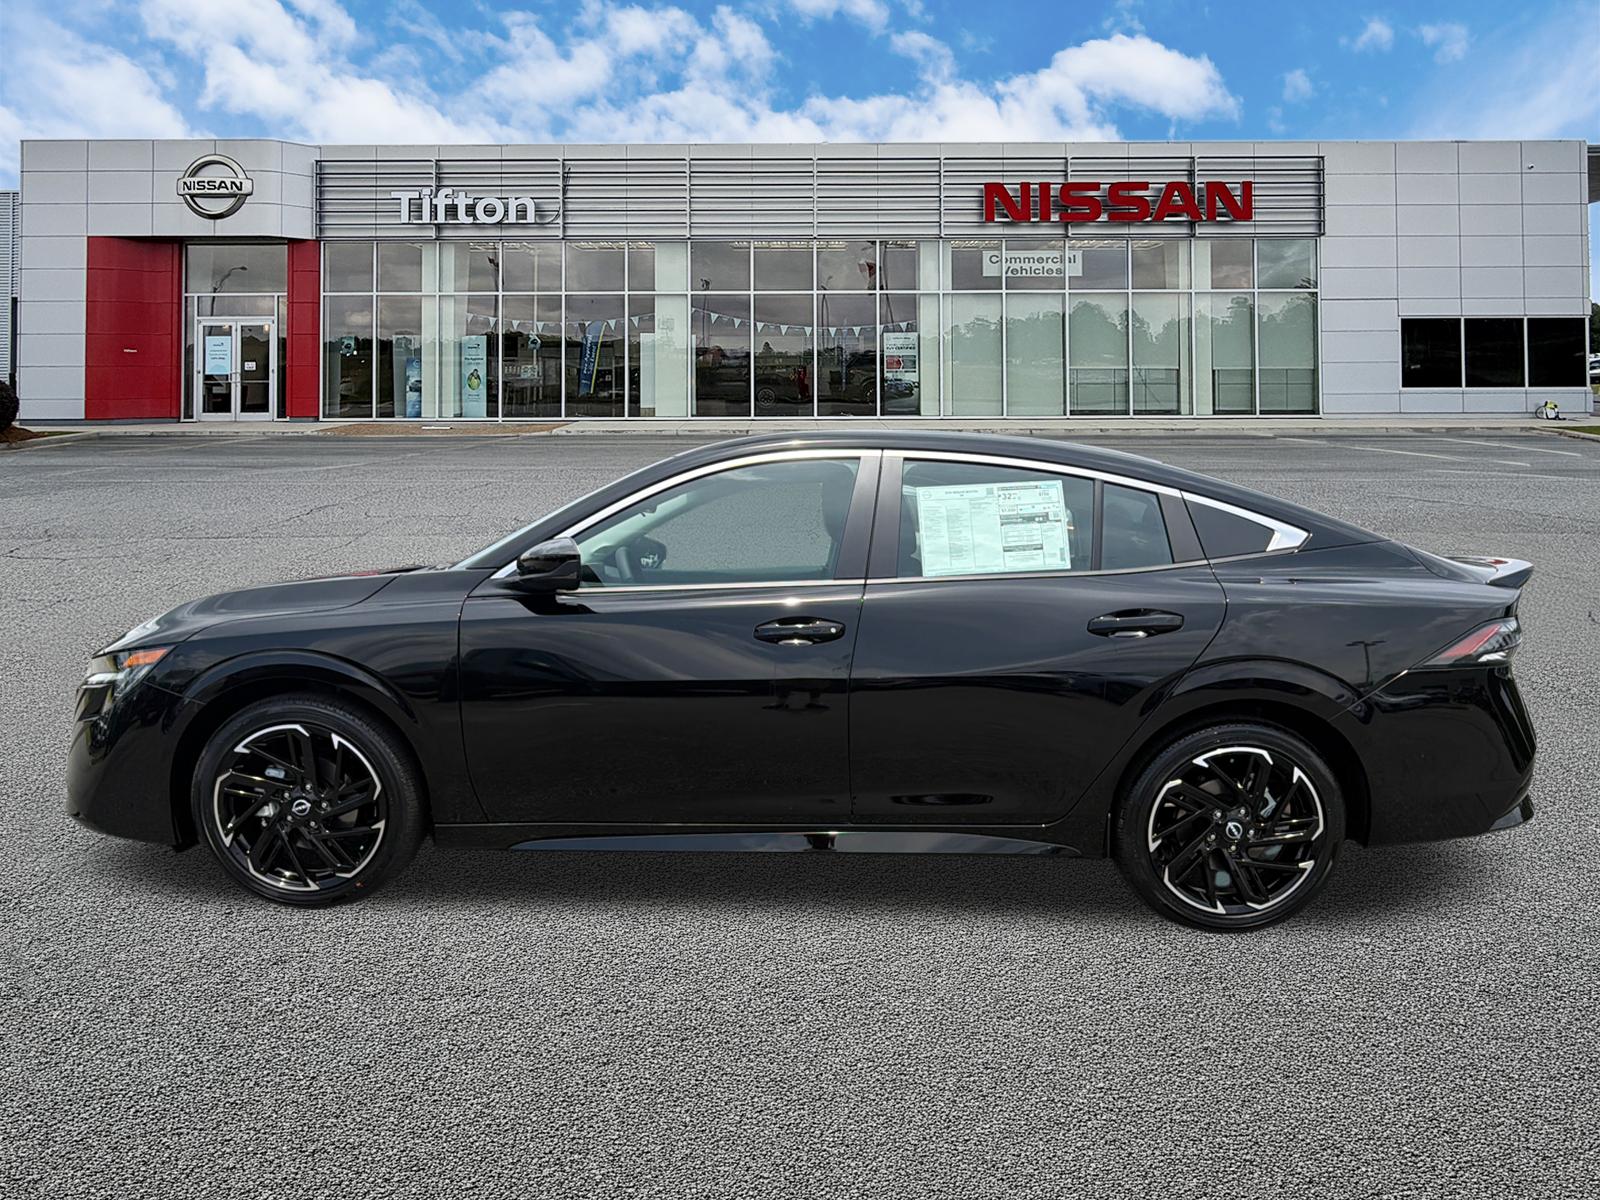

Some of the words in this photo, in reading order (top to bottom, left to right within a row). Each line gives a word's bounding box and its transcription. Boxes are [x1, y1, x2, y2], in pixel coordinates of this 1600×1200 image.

[183, 181, 243, 191] NISSAN
[984, 181, 1253, 221] NISSAN
[391, 188, 536, 224] Tifton
